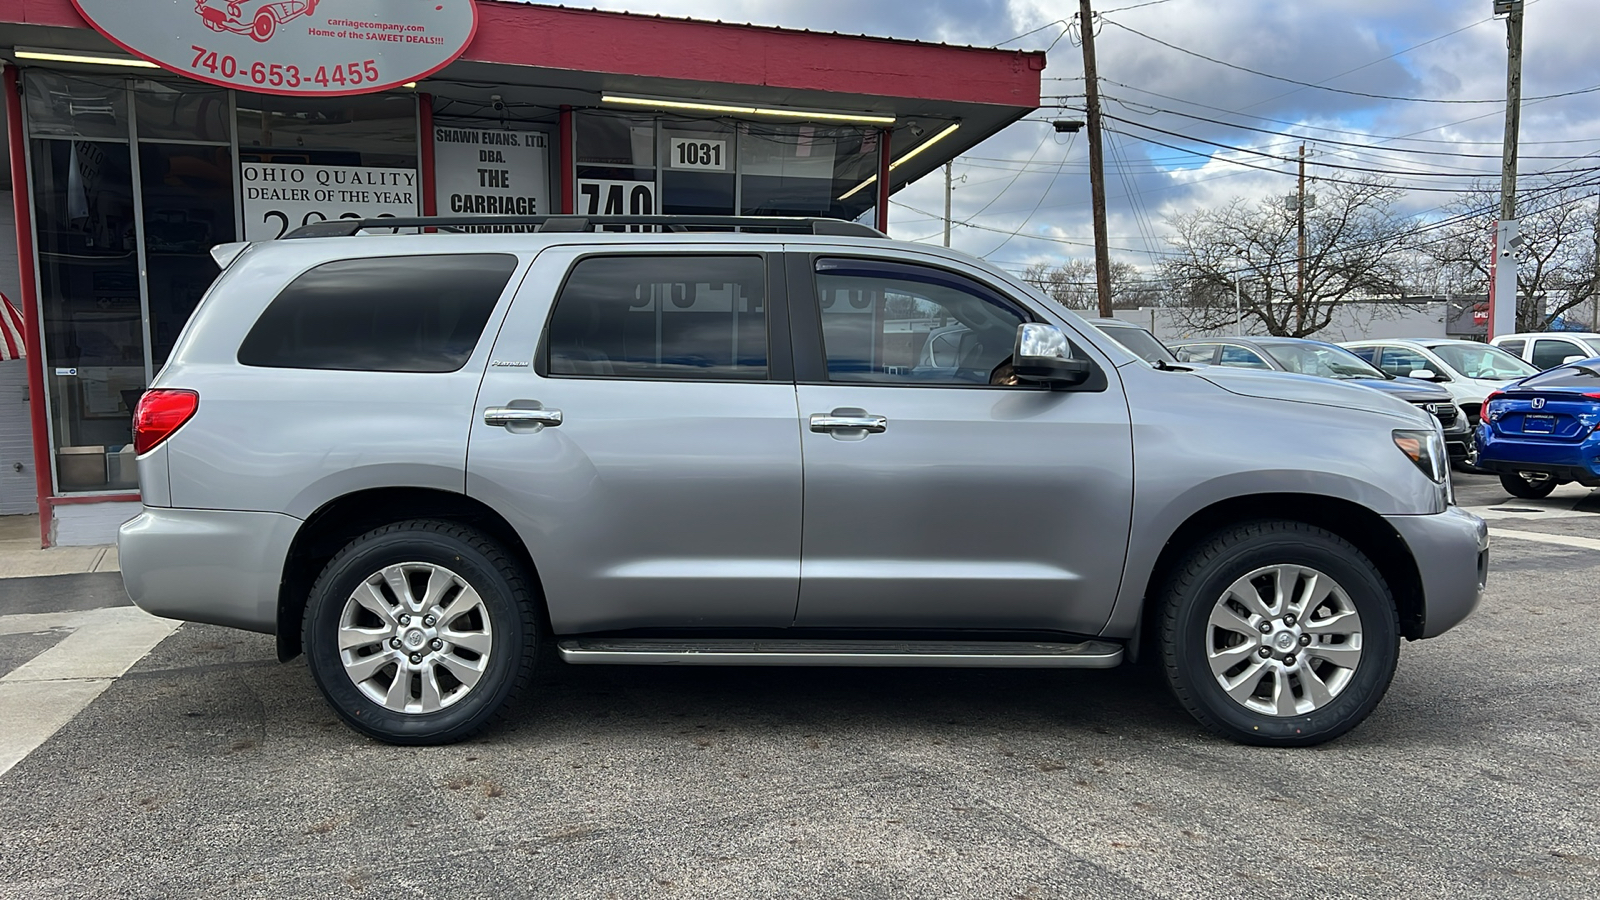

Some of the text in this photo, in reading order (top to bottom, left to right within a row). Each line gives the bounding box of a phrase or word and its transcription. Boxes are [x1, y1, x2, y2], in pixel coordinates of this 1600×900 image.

[327, 18, 425, 33] carriagecompany.com
[308, 28, 444, 45] Home of the SAWEET DEALS!!!
[191, 45, 379, 87] 740-653-4455
[436, 129, 479, 144] SHAWN
[525, 135, 547, 148] LTD.
[479, 149, 506, 163] DBA.
[677, 142, 721, 166] 1031
[244, 167, 415, 187] OHIO QUALITY
[477, 169, 510, 188] THE
[247, 187, 414, 205] DEALER OF THE YEAR
[450, 194, 537, 215] CARRIAGE
[581, 183, 652, 232] 740
